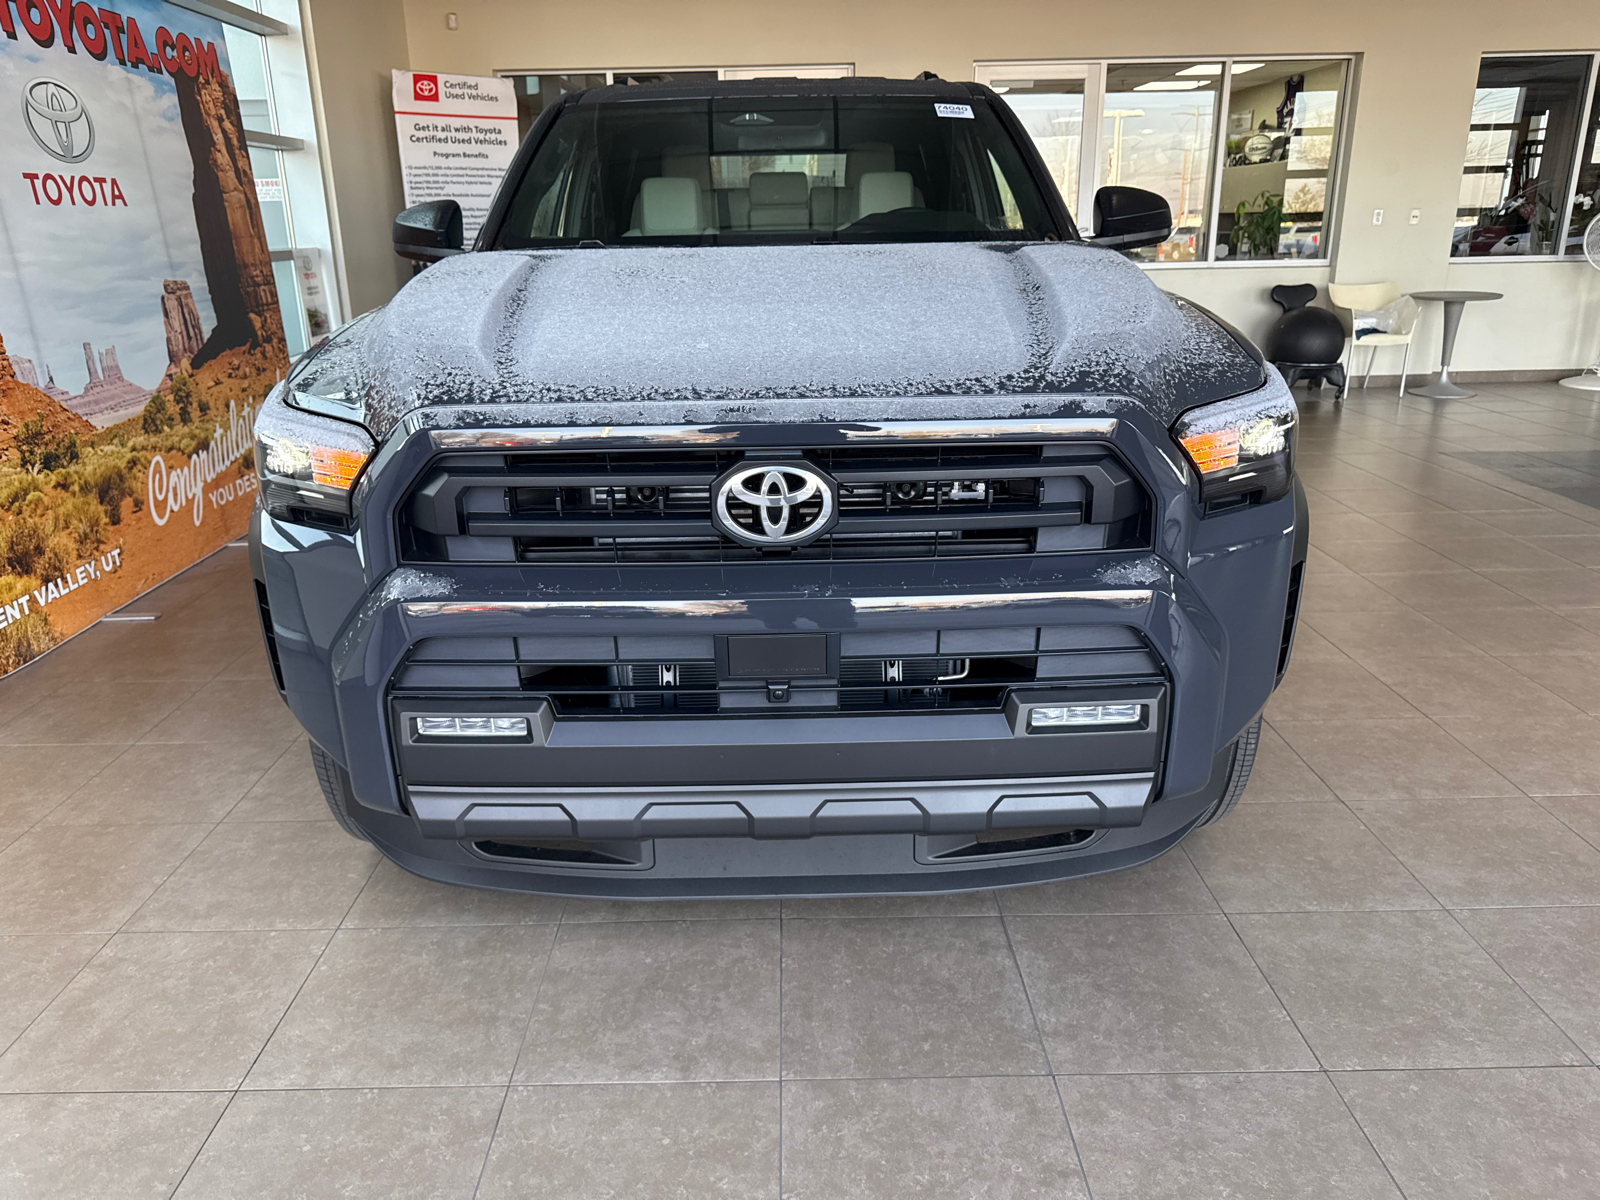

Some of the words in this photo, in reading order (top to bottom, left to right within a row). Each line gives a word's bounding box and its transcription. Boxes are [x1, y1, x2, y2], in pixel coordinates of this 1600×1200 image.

[444, 80, 478, 91] Certified
[445, 91, 465, 100] Used
[466, 92, 499, 102] Vehicles
[413, 123, 432, 132] Get
[432, 124, 439, 132] it
[440, 124, 452, 133] all
[453, 125, 473, 134] with
[474, 126, 502, 136] Toyota
[409, 134, 449, 144] Certified
[450, 136, 472, 145] Used
[473, 136, 508, 147] Vehicles
[433, 151, 461, 160] Program
[22, 172, 128, 207] TOYOTA
[208, 483, 235, 509] YOU
[235, 472, 258, 497] DES
[0, 594, 30, 630] ENT
[33, 560, 101, 607] VALLEY,
[101, 548, 121, 572] UT
